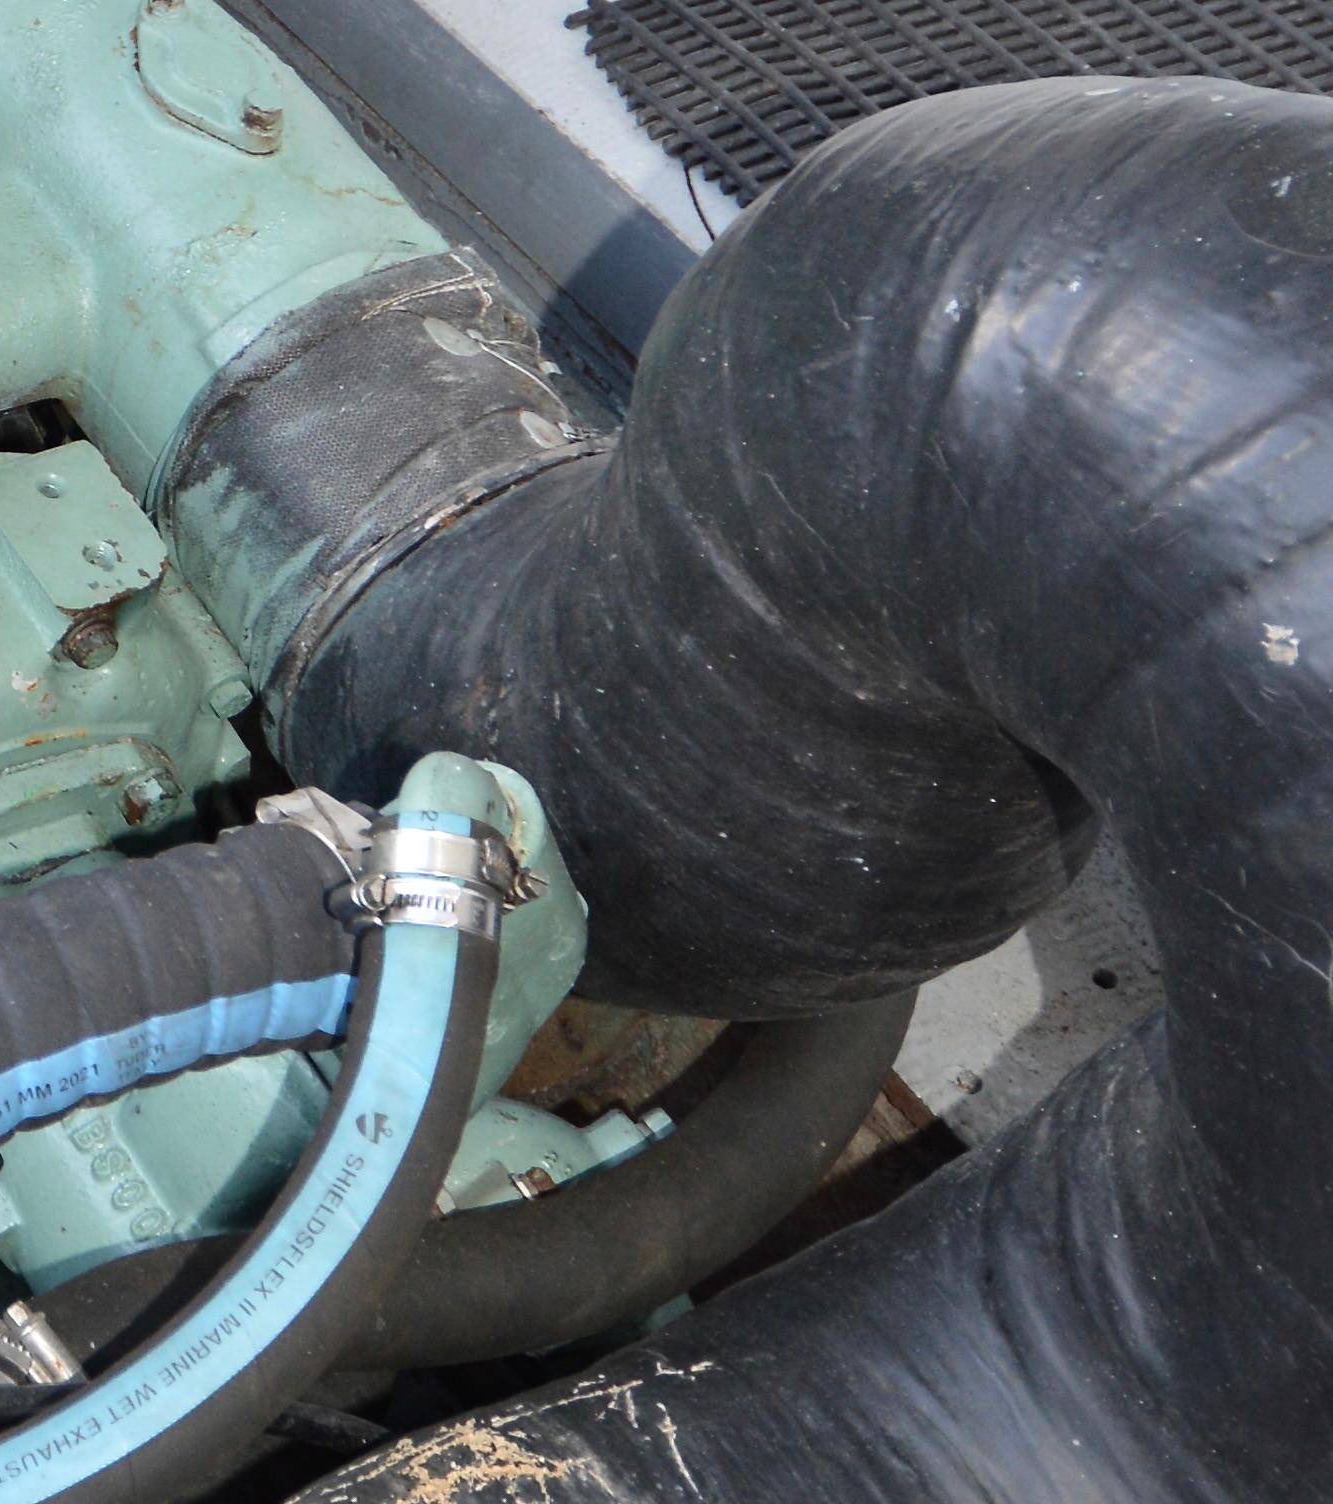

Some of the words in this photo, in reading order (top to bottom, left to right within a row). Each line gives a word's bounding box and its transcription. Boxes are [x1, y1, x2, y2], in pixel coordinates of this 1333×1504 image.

[17, 1082, 53, 1105] MM
[257, 1153, 365, 1302] SHIELDSFLEX
[239, 1302, 258, 1319] II
[161, 1316, 242, 1387] MARINE
[108, 1384, 158, 1417] WET
